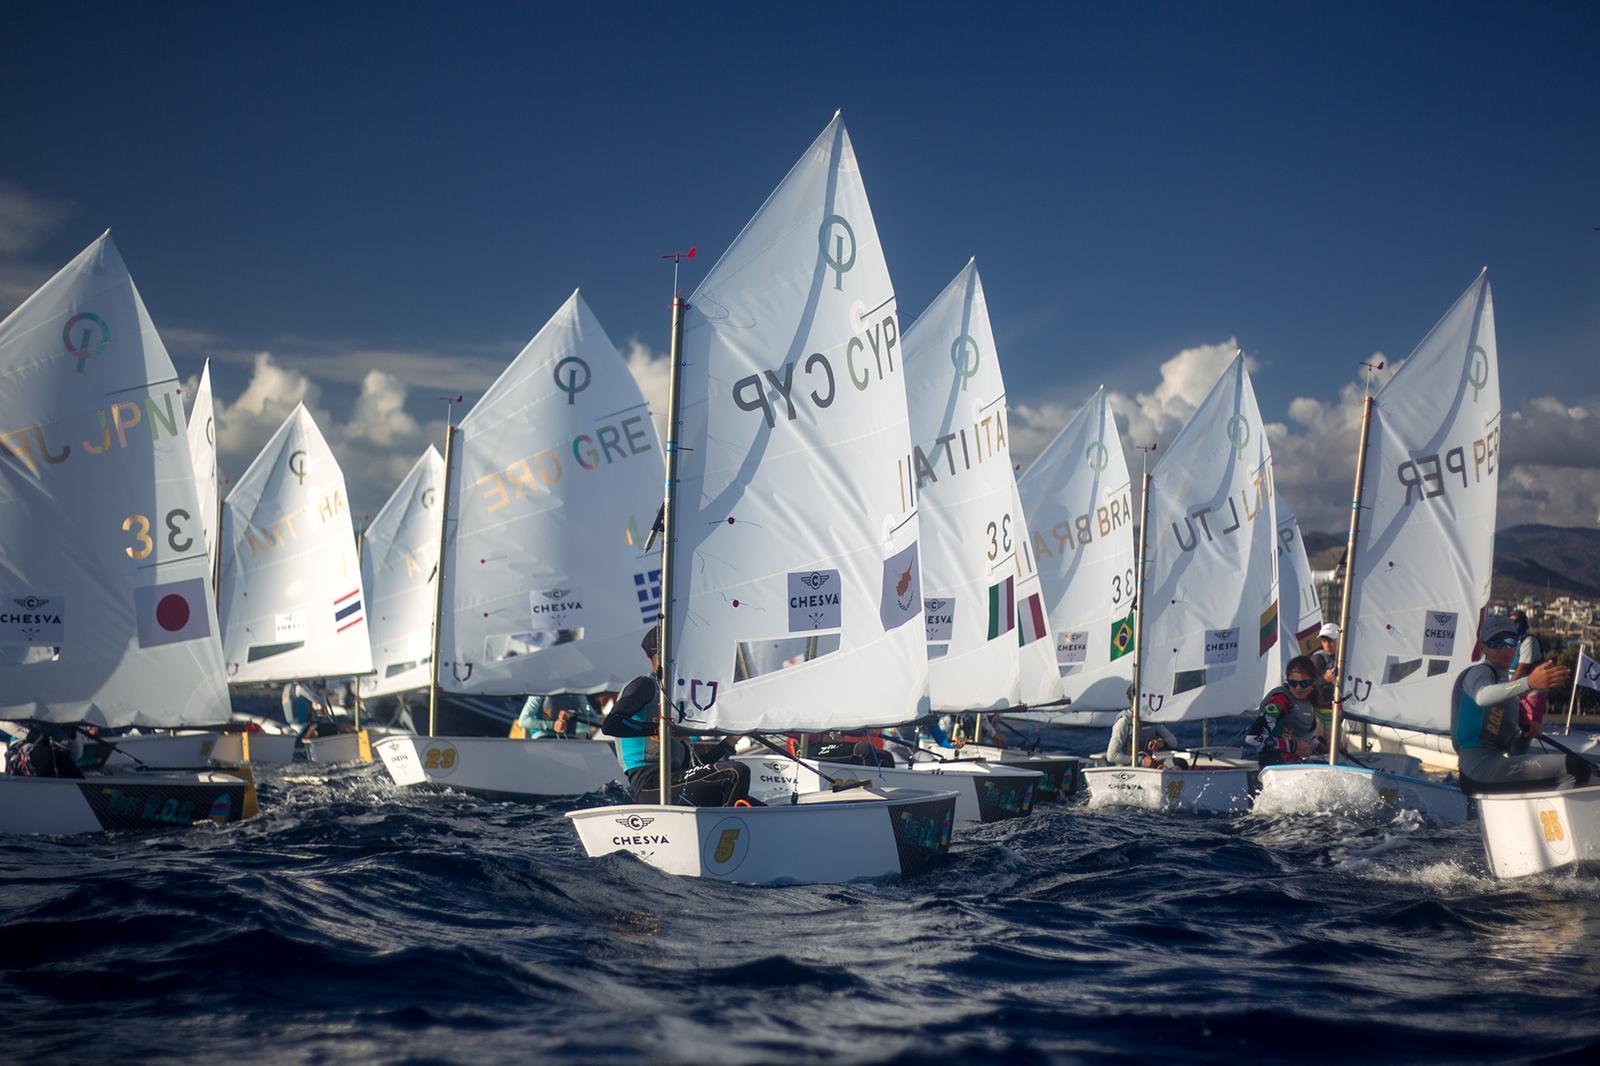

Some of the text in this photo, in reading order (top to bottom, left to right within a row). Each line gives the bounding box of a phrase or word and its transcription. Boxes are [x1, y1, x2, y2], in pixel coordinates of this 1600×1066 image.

[847, 315, 897, 391] CYP
[82, 392, 178, 455] JPN
[975, 410, 1006, 464] ITA
[572, 416, 652, 470] GRE
[1096, 493, 1131, 538] BRA
[121, 515, 154, 560] 3
[987, 521, 998, 561] 3
[790, 594, 840, 608] CHESVA
[1112, 575, 1122, 604] 3
[0, 613, 62, 624] CHESVA
[533, 602, 583, 613] CHESVA
[925, 615, 952, 625] ESVA
[1057, 644, 1086, 652] CHESVA
[1206, 642, 1238, 651] CHESVA
[760, 775, 799, 784] CHESVA
[612, 835, 670, 846] CHESVA
[714, 828, 741, 864] 5
